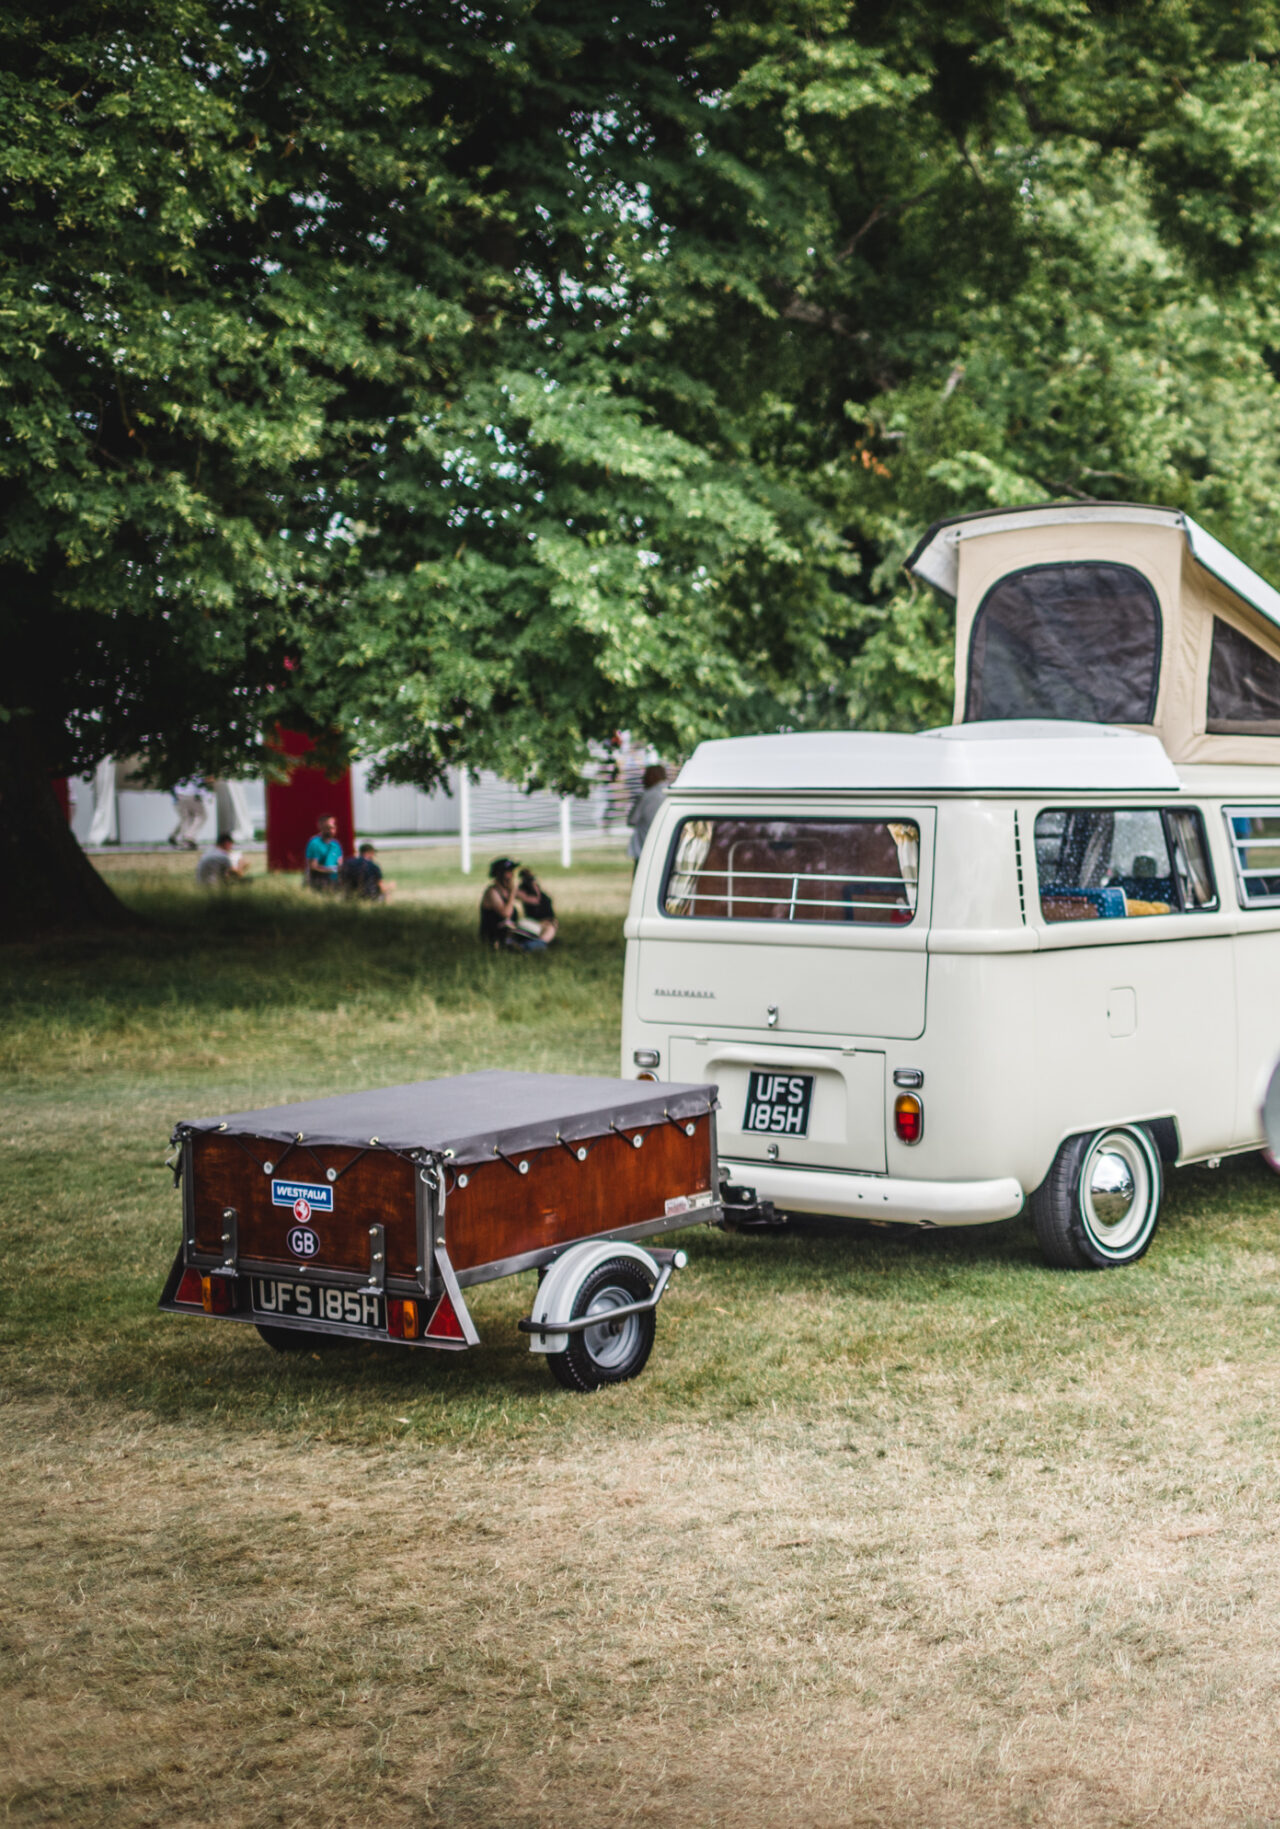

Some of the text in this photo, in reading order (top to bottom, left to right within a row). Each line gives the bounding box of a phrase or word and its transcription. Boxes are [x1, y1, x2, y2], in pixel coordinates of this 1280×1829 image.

[757, 1075, 804, 1103] UFS
[748, 1103, 804, 1132] 185H
[276, 1185, 327, 1201] WESTFALIA
[292, 1231, 314, 1253] GB
[260, 1280, 379, 1326] UFS 185H
